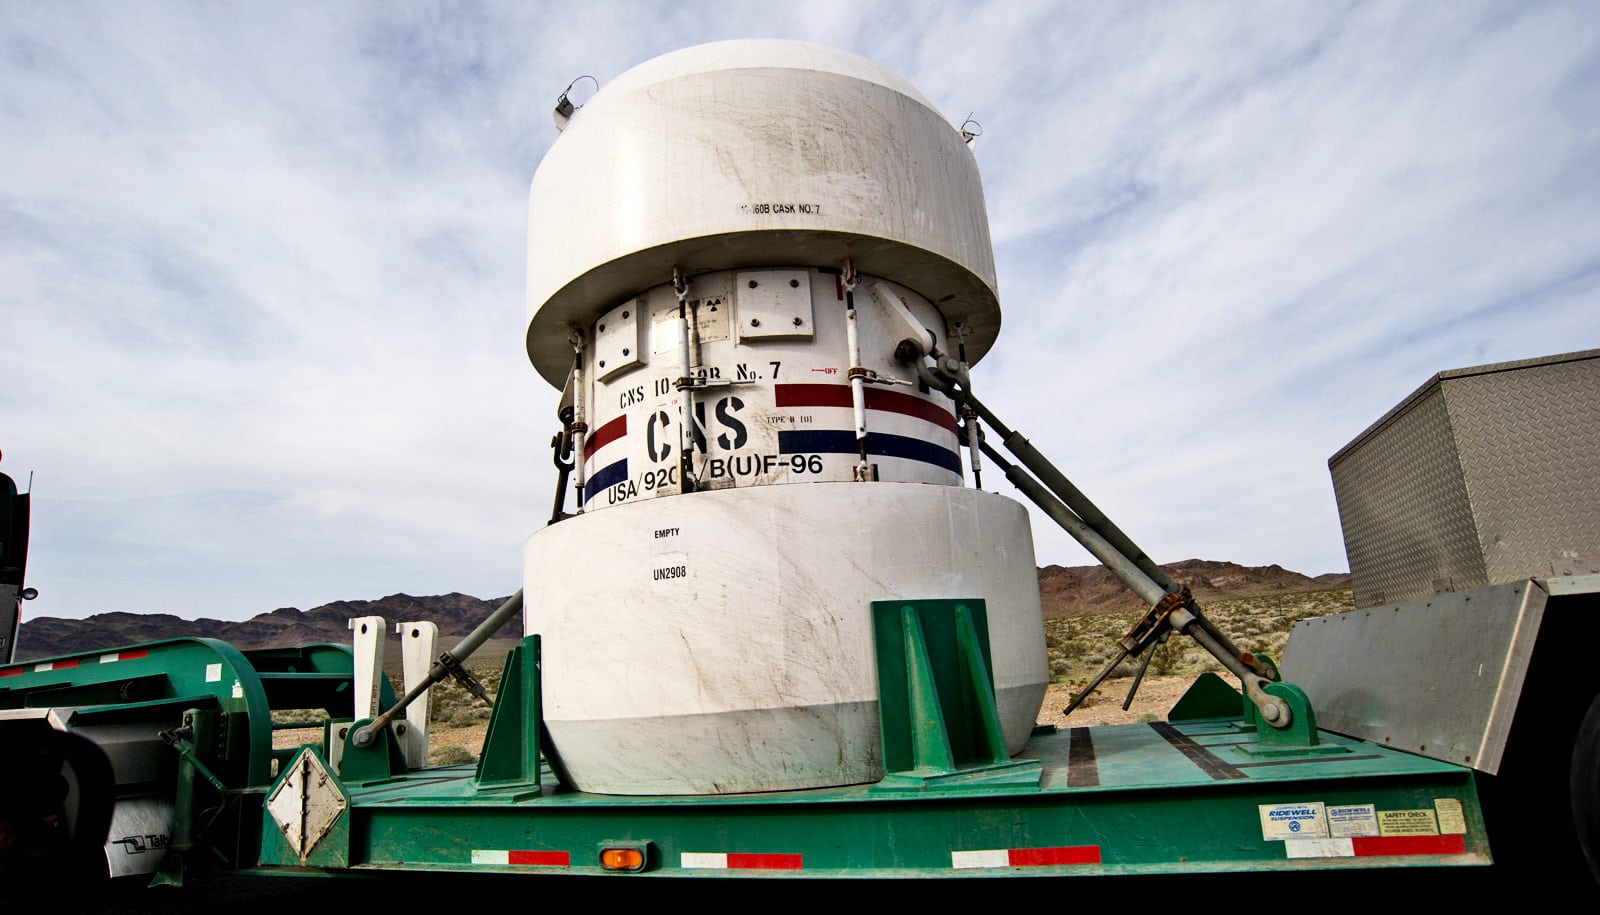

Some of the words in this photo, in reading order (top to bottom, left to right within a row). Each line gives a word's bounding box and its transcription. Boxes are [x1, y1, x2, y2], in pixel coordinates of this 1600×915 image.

[772, 204, 796, 214] CASK
[799, 204, 814, 214] NO.
[815, 204, 820, 214] 7
[824, 367, 838, 375] OFF
[620, 385, 645, 409] CNS
[736, 363, 763, 381] No.
[769, 361, 782, 379] 7
[766, 416, 786, 424] TYPE
[647, 396, 748, 463] CNS
[608, 454, 823, 505] USA/920/B(U)F-96
[654, 527, 680, 539] EMPTY
[653, 565, 687, 581] UN2908
[1268, 809, 1317, 817] RIDEWELL
